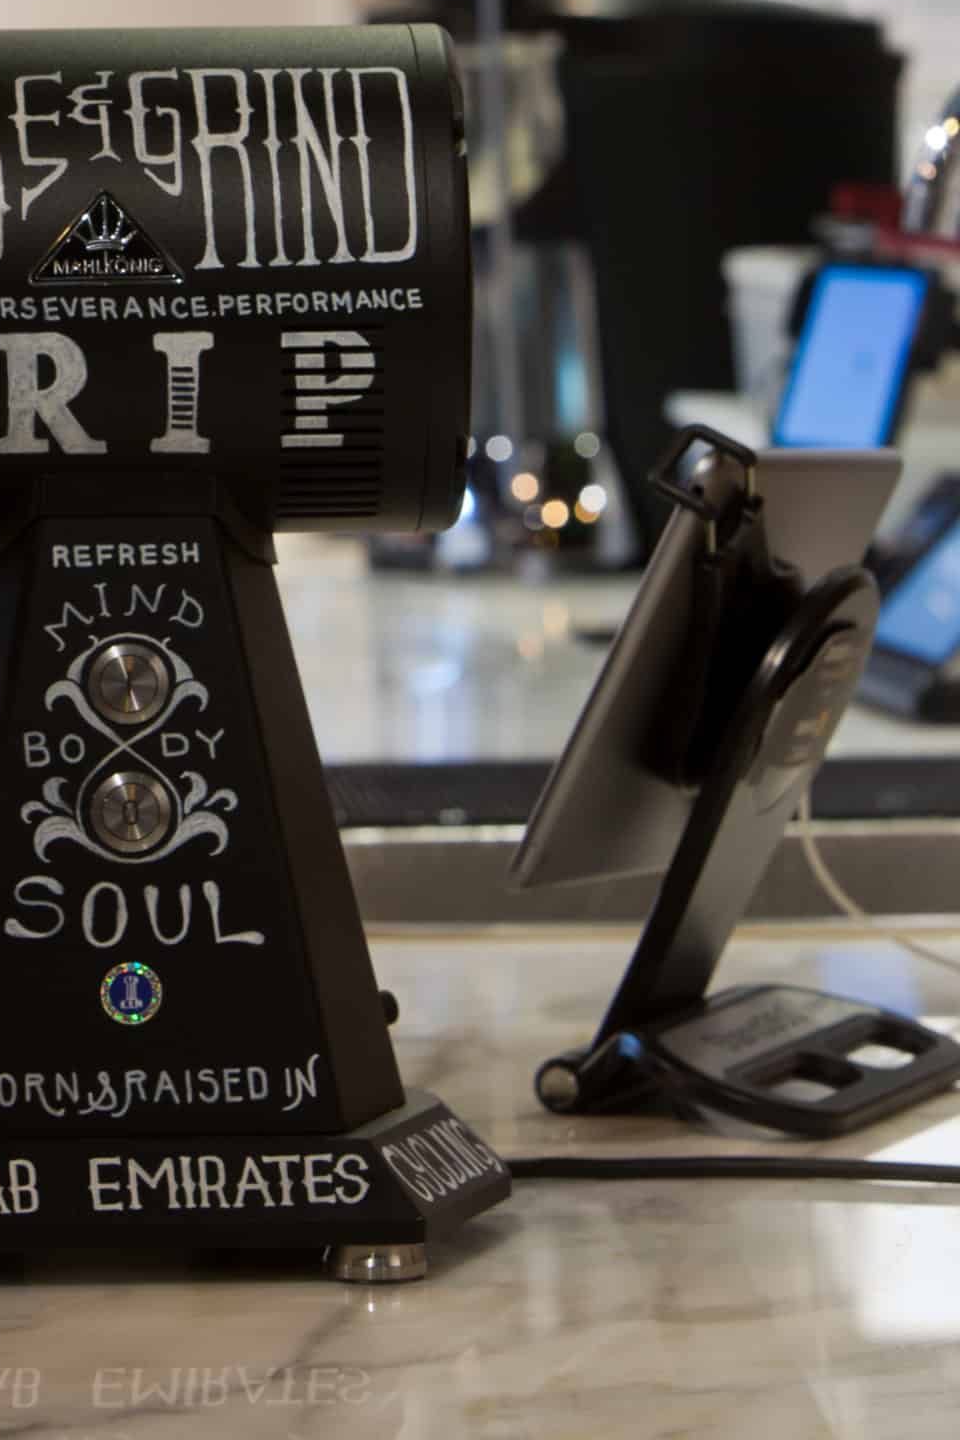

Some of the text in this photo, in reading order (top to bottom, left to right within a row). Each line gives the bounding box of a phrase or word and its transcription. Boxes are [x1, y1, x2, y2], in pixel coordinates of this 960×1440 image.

[52, 542, 200, 569] REFRESH
[44, 582, 204, 652] MIND
[4, 875, 265, 949] SOUL
[283, 1053, 320, 1112] IN
[88, 1153, 371, 1212] EMIRATES
